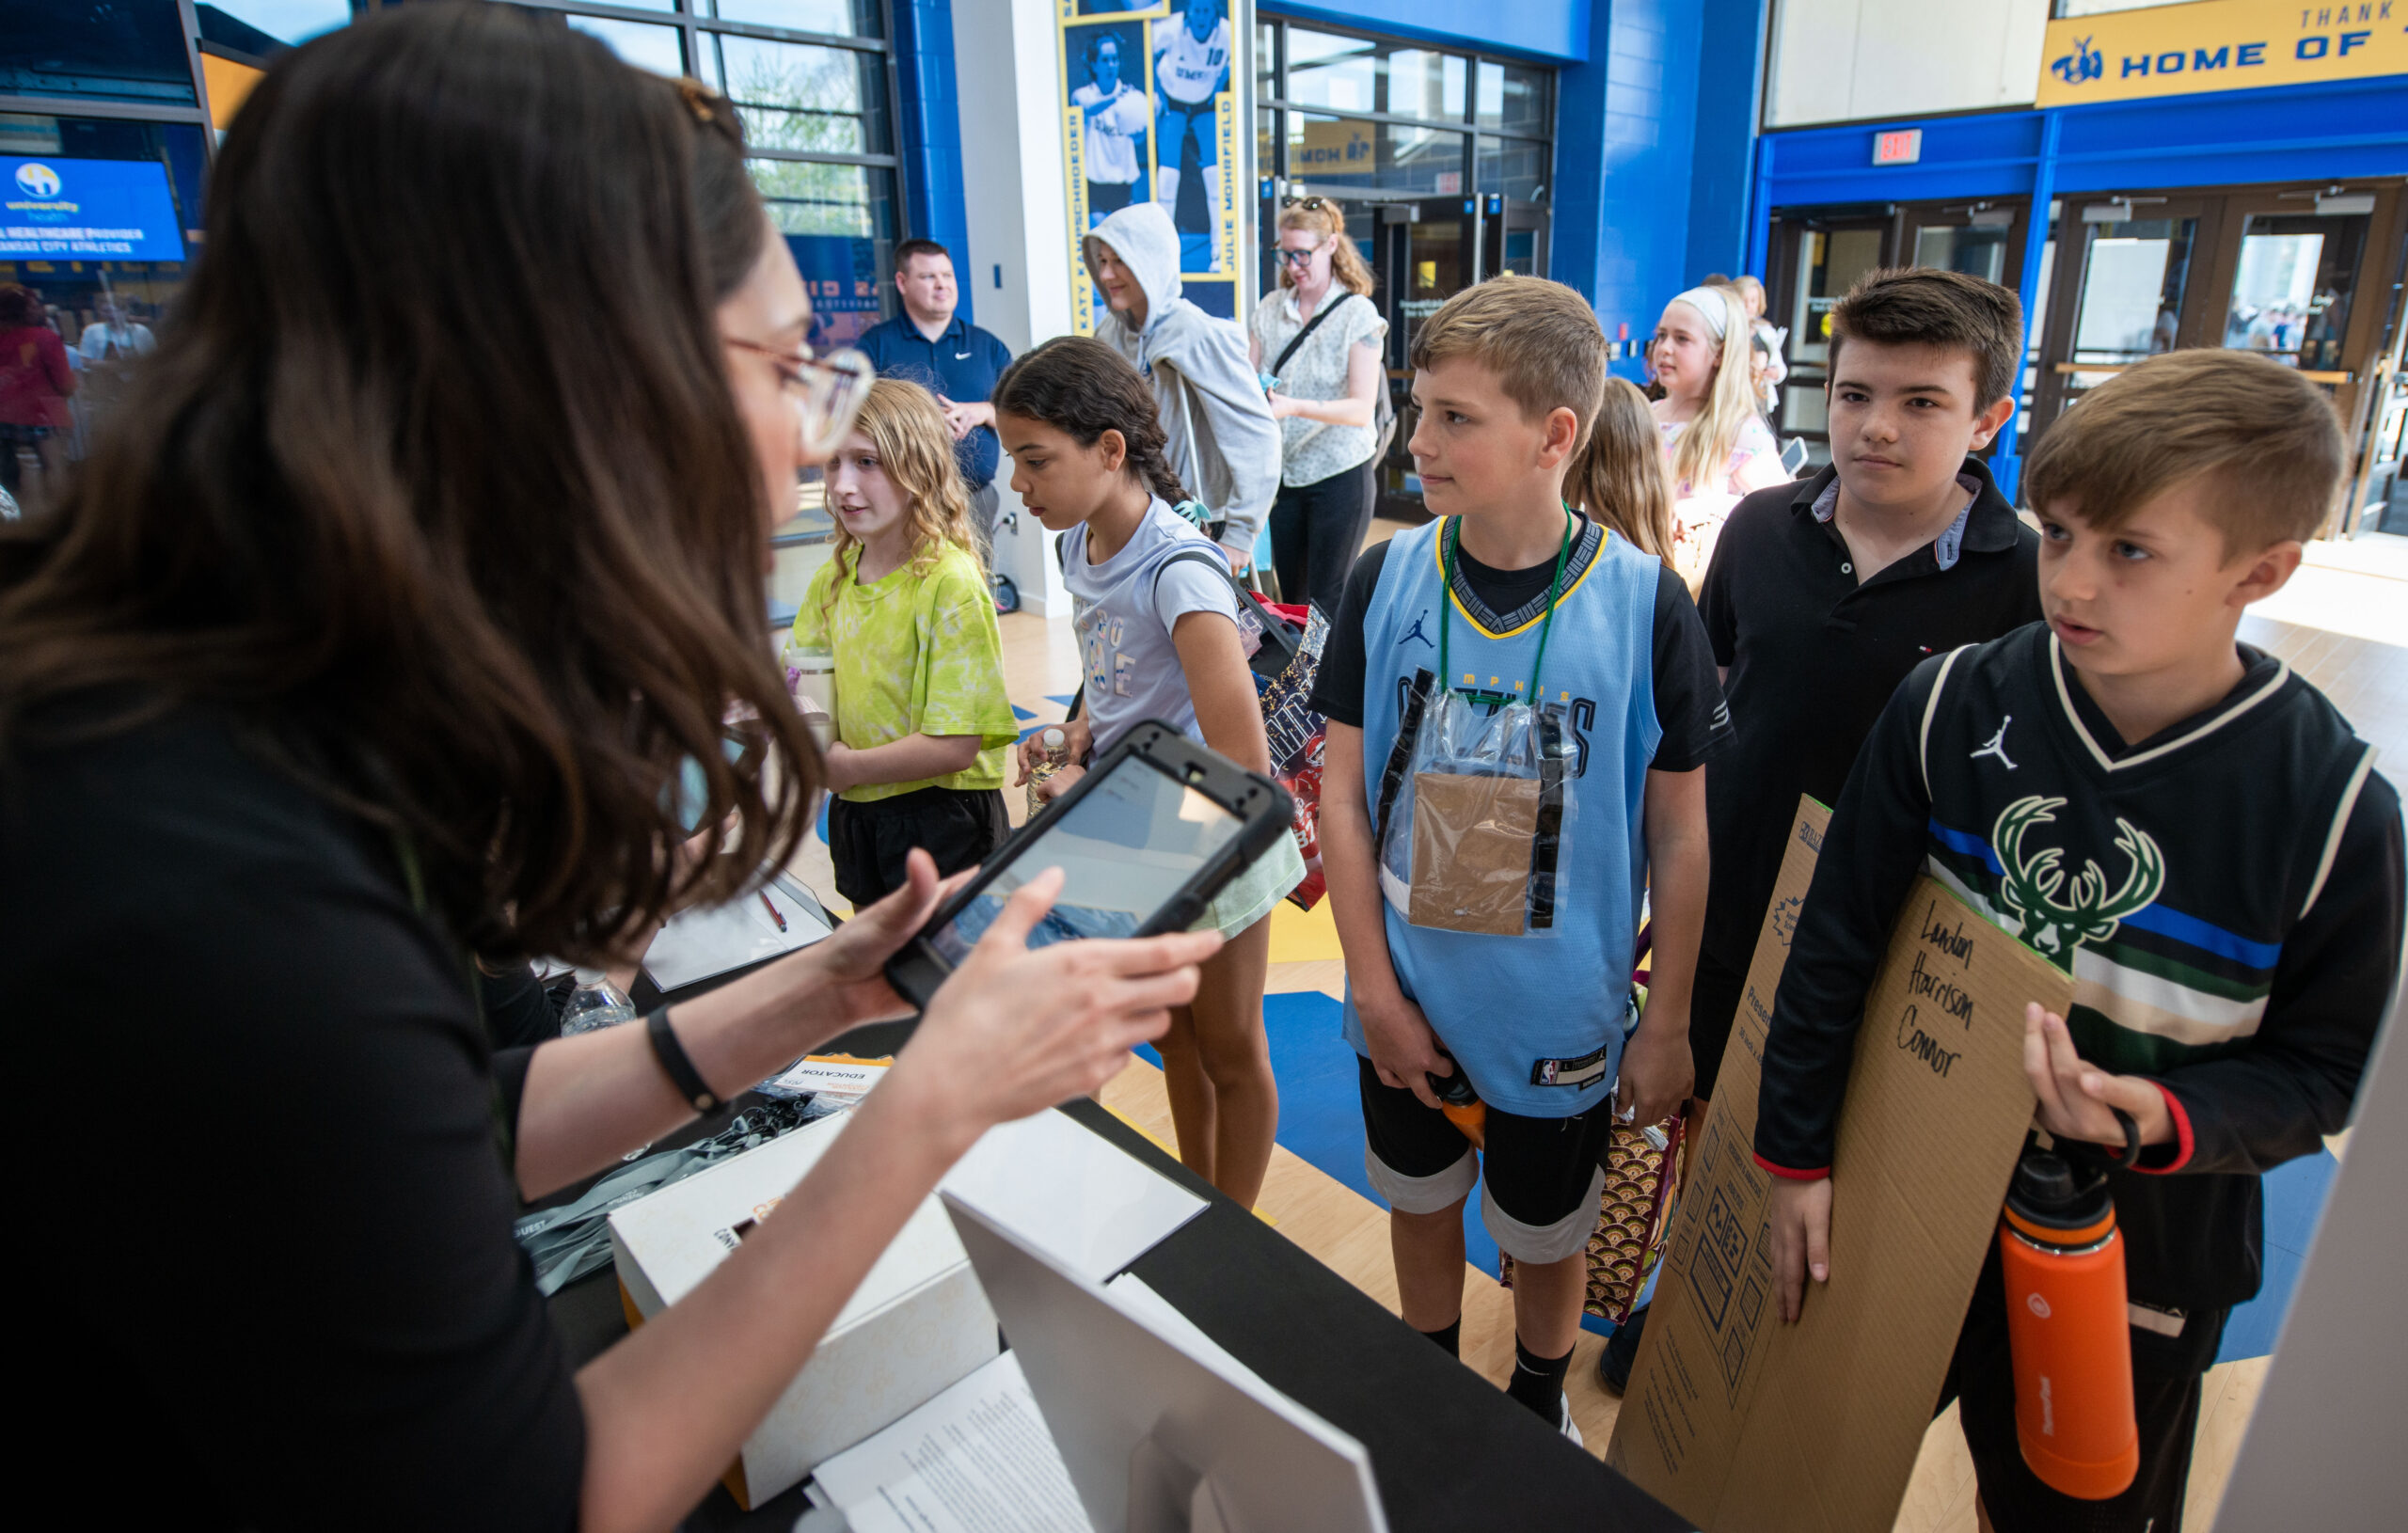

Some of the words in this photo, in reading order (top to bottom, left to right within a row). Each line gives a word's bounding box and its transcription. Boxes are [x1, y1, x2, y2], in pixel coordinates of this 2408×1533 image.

[2302, 1, 2393, 28] THANK
[1206, 47, 1223, 66] 10
[2120, 41, 2268, 79] HOME
[2295, 30, 2372, 59] OF
[1222, 101, 1233, 211] MOHRFIELD
[1880, 133, 1914, 161] EXIT
[0, 240, 40, 252] ANSAS
[40, 241, 69, 252] CITY
[71, 241, 133, 254] ATHLETICS
[6, 227, 84, 240] HEALTHCARE
[85, 228, 144, 241] PROVIDER
[1225, 218, 1235, 272] JULIE
[1078, 285, 1087, 329] KATY
[1464, 673, 1570, 702] MPHIS
[1808, 828, 1824, 847] BAZ
[1921, 899, 1973, 970] Landon
[1748, 985, 1771, 1027] Presen
[1909, 950, 1973, 1031] Harrison
[1898, 1004, 1961, 1078] Connor
[801, 1068, 865, 1080] EDUCATOR
